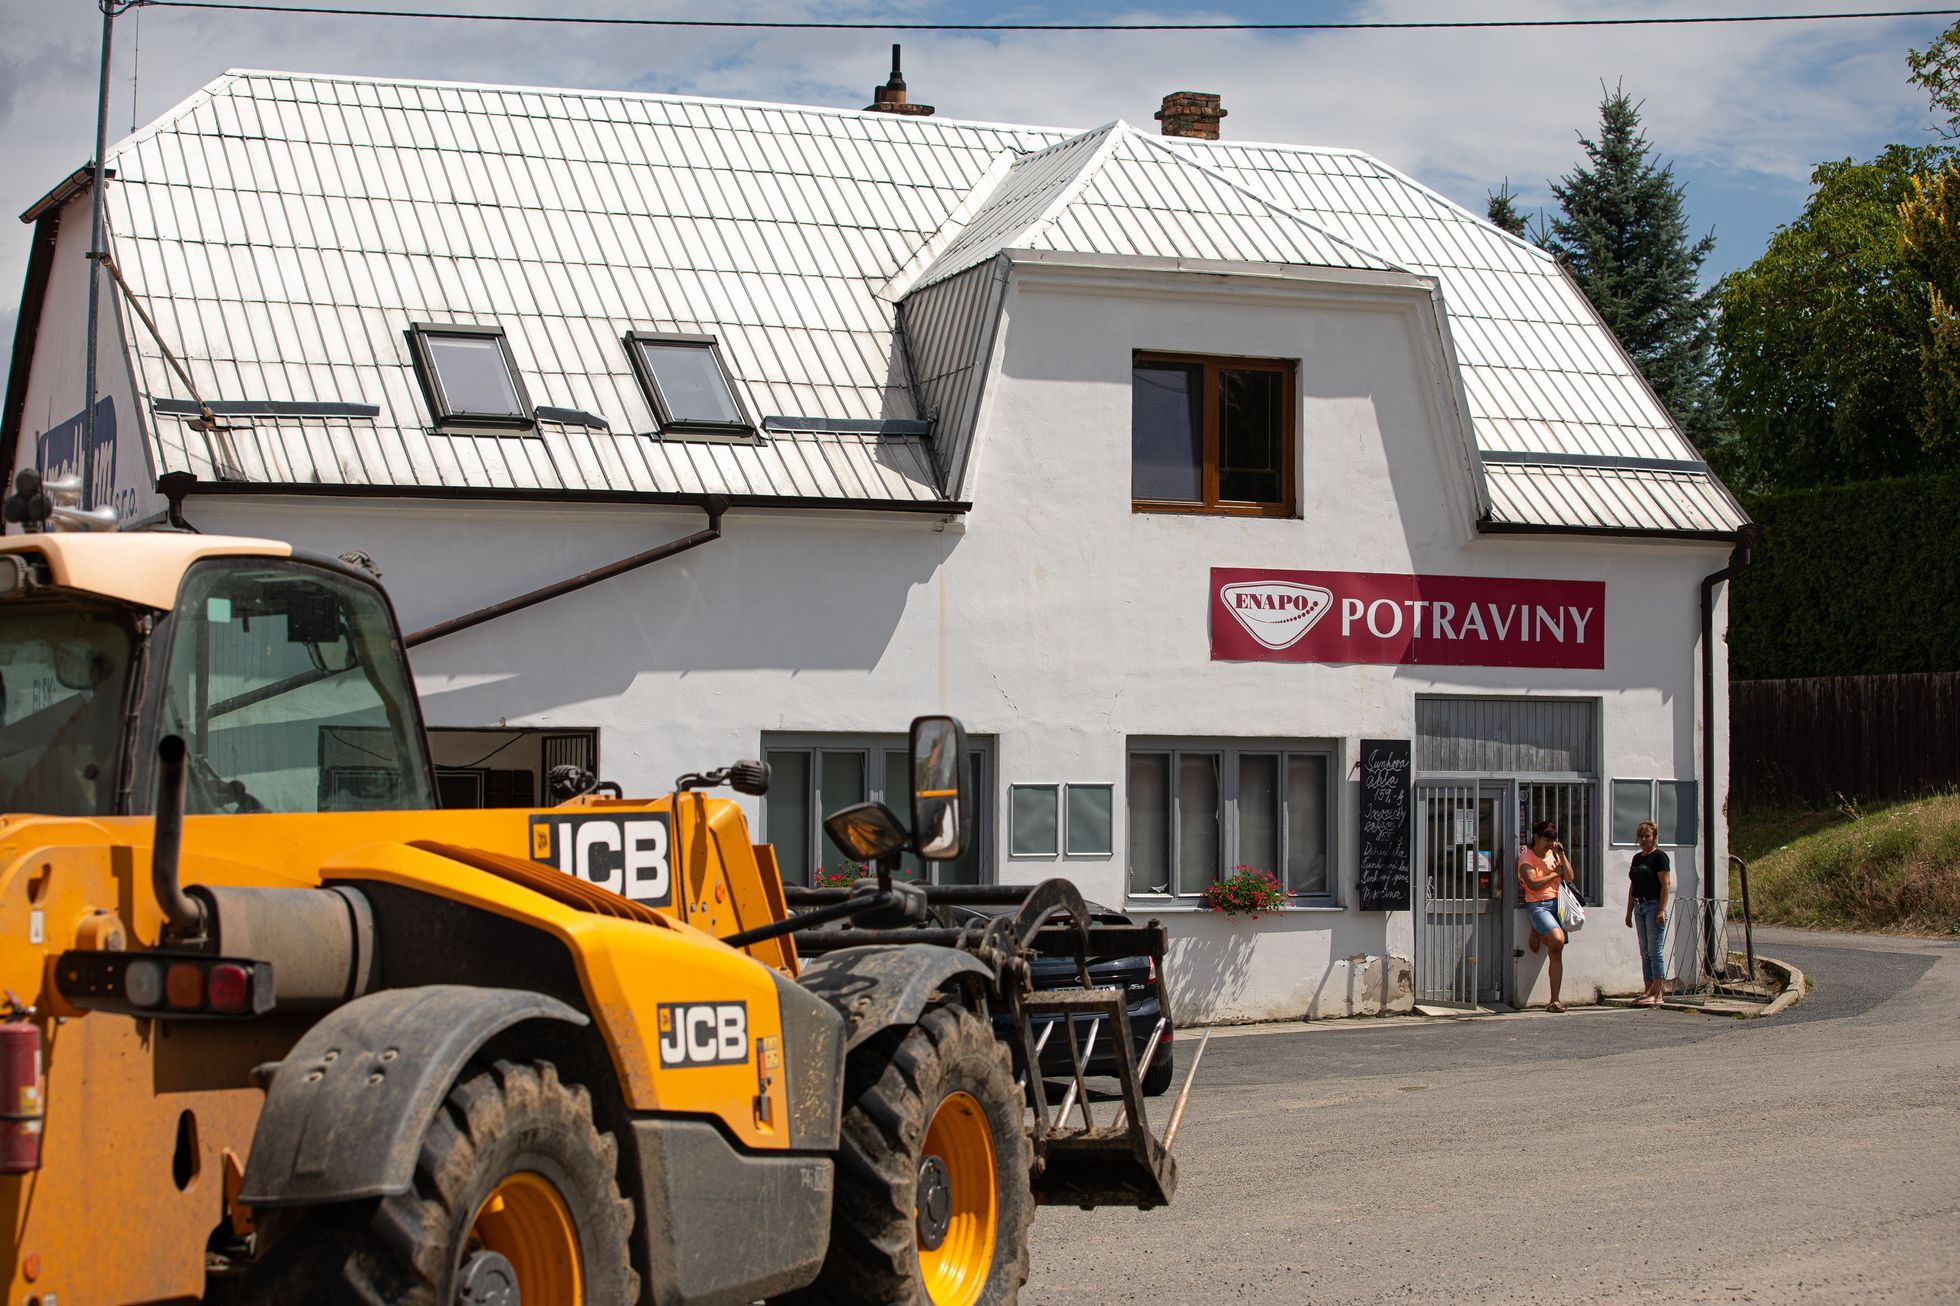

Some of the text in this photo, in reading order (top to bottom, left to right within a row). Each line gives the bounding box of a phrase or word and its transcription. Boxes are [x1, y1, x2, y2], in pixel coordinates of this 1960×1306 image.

[1235, 593, 1308, 611] ENAPO
[1341, 598, 1593, 644] POTRAVINY
[558, 819, 670, 901] JCB
[660, 1005, 748, 1064] JCB
